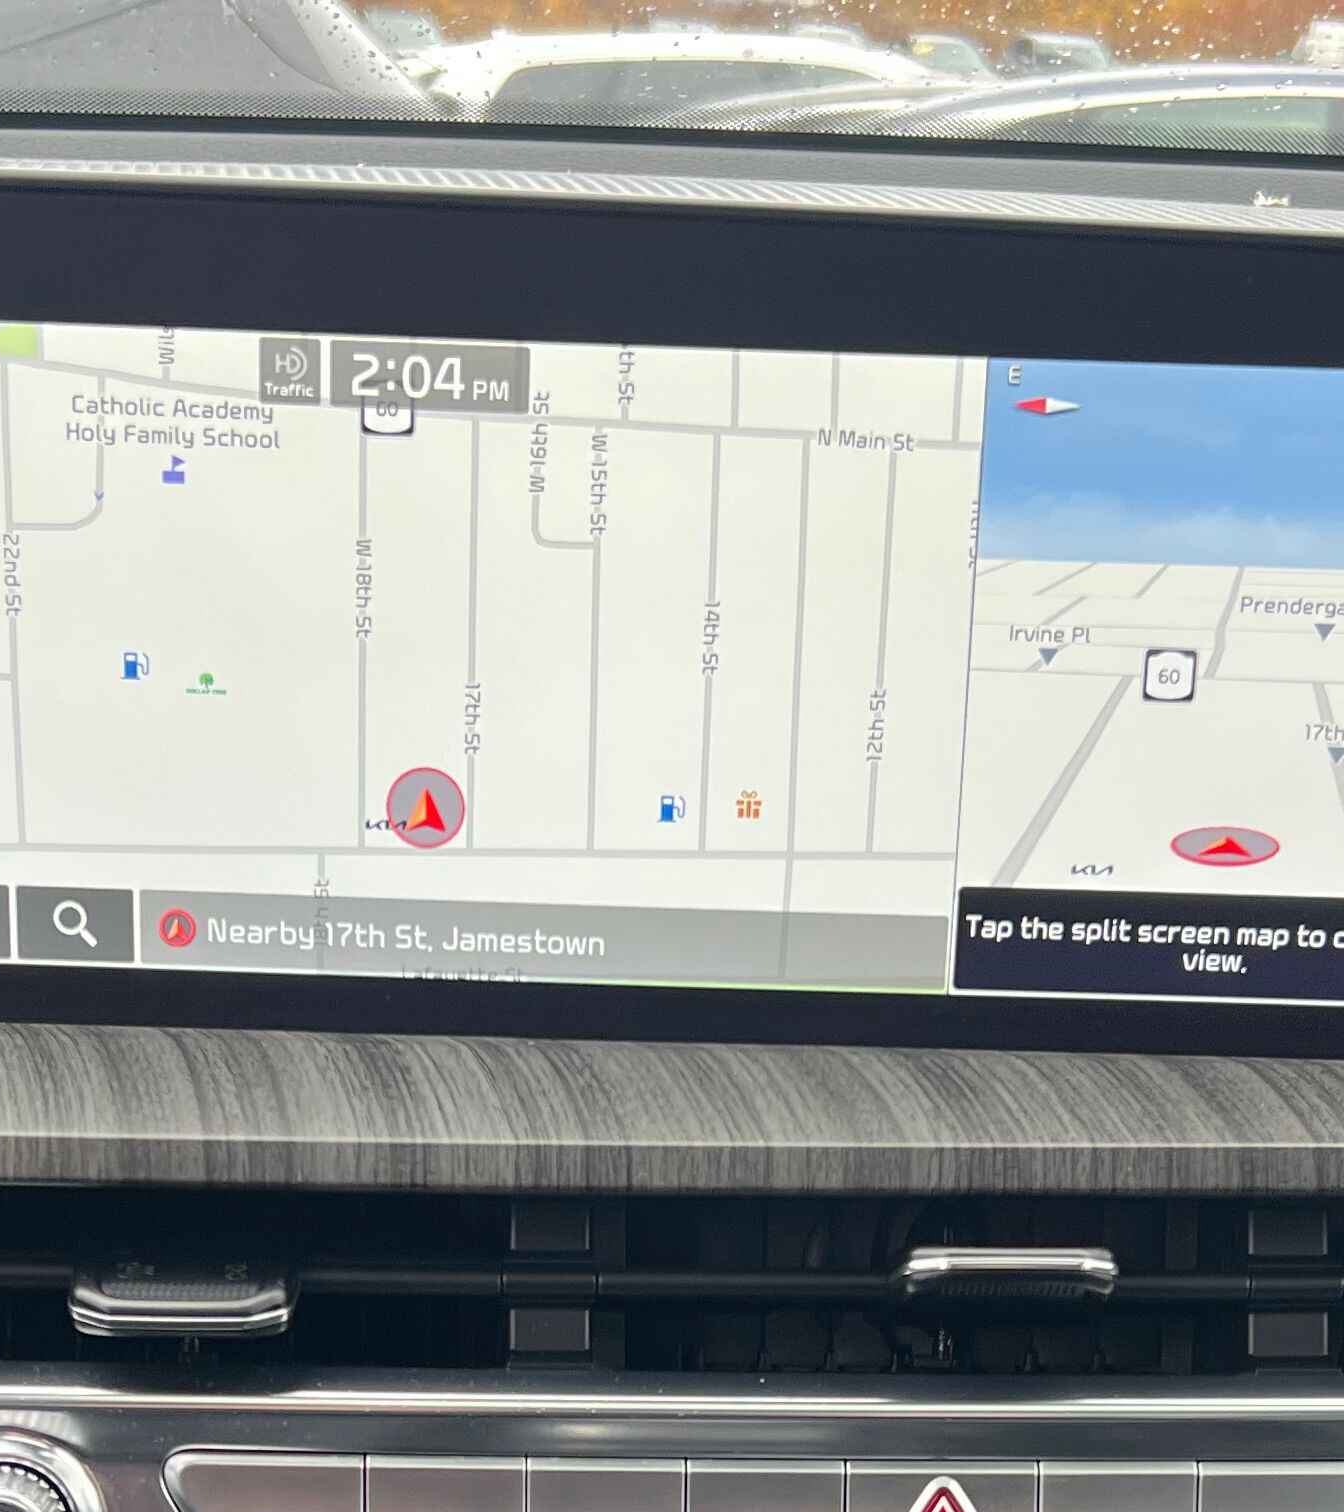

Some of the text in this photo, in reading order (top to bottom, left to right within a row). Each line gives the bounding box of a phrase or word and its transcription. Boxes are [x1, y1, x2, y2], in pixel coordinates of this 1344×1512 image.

[264, 382, 314, 398] Traffic
[351, 353, 510, 402] 2:04 PM
[1008, 365, 1022, 385] E
[71, 394, 274, 424] Catholic Academy
[618, 382, 635, 405] St
[65, 423, 281, 450] Holy Family School
[529, 391, 550, 493] W 16th St
[818, 429, 914, 452] N Main St
[589, 435, 607, 536] W 15th St
[3, 534, 21, 616] 22nd St
[355, 538, 373, 638] W 18th St
[702, 601, 721, 676] 14th St
[1008, 624, 1092, 646] Irvine Pl
[1158, 668, 1181, 686] 60
[464, 683, 481, 755] 17th St
[866, 689, 887, 762] 12th St
[313, 878, 330, 900] St
[207, 917, 316, 950] Nearby
[325, 921, 386, 948] 17th
[442, 926, 606, 957] Jamestown
[965, 914, 1014, 941] Tap
[1020, 917, 1064, 940] the
[1071, 918, 1132, 946] split
[1137, 924, 1230, 946] screen
[1236, 927, 1288, 950] map
[1296, 926, 1327, 948] to
[1181, 950, 1248, 974] view.
